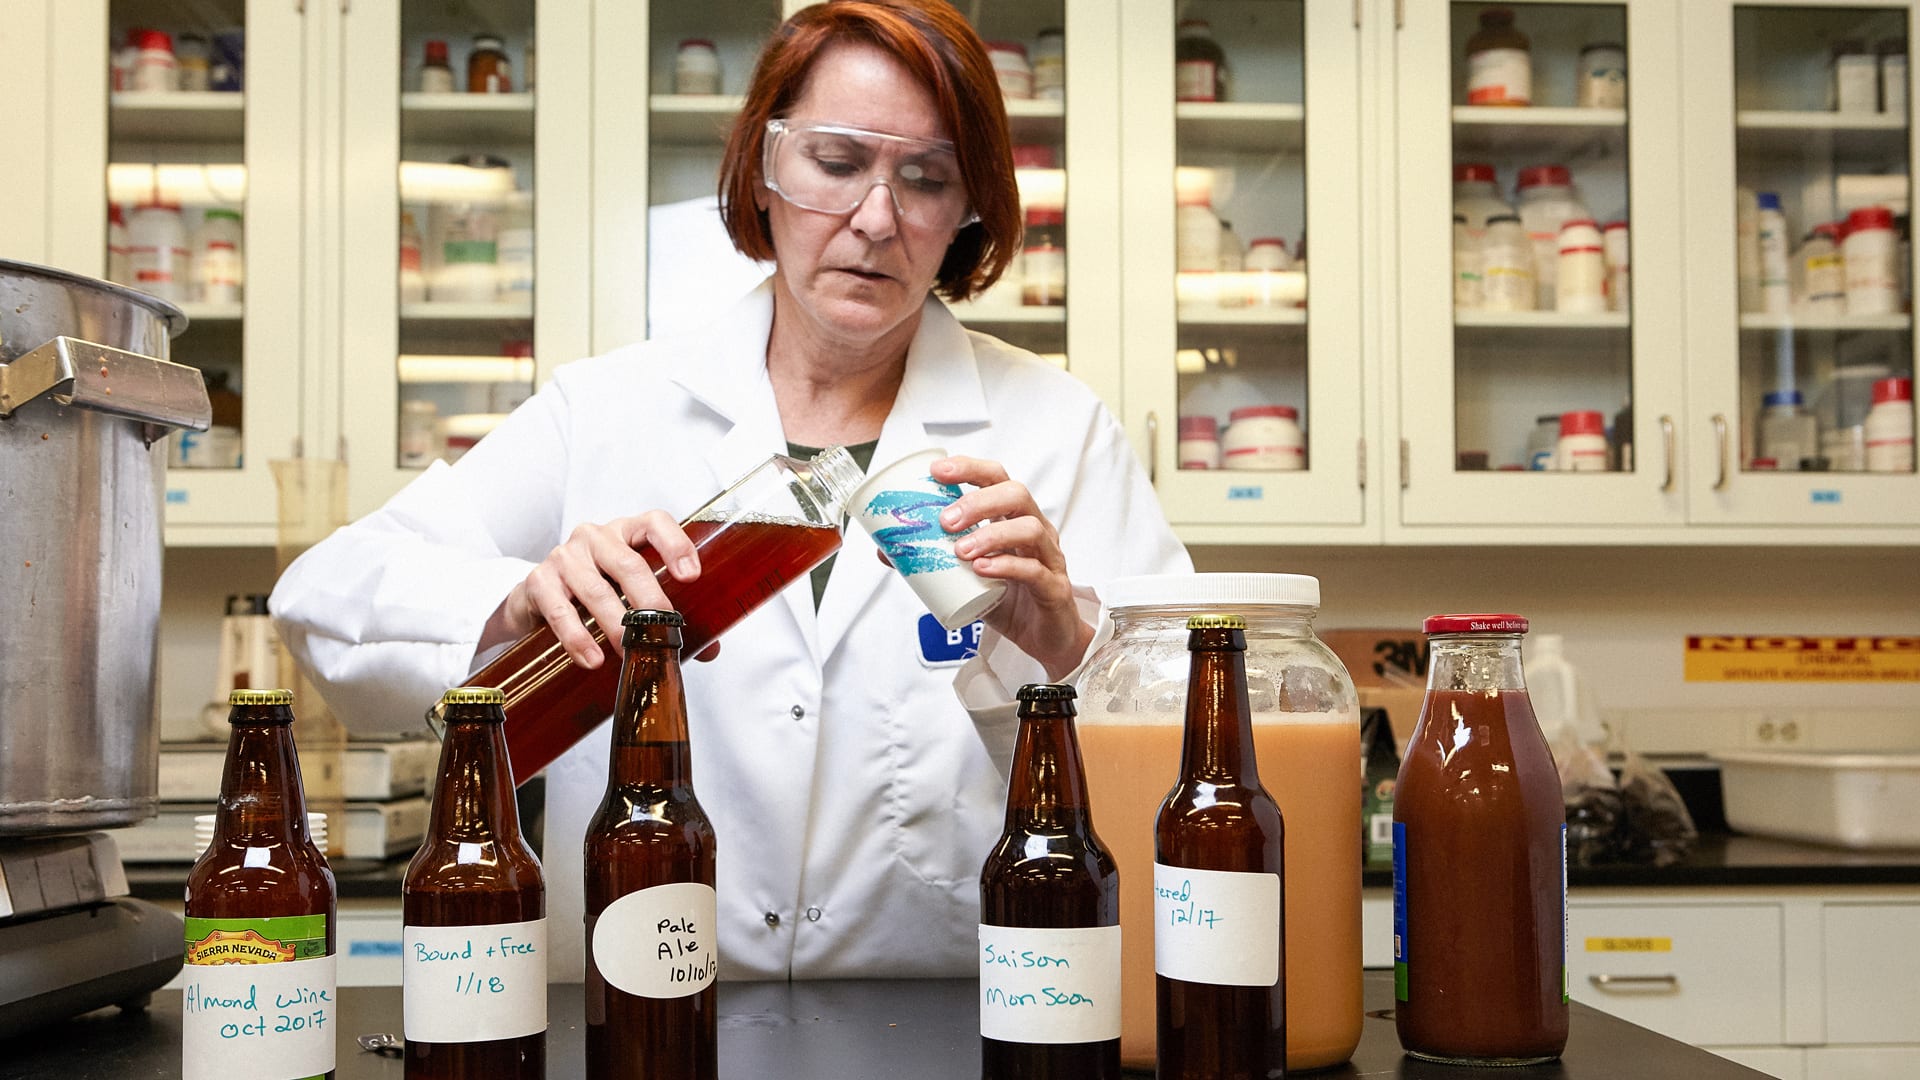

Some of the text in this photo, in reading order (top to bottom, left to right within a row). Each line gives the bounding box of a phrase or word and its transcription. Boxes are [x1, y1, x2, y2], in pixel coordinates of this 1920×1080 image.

[1470, 621, 1490, 630] Shake
[1492, 621, 1505, 629] well
[1374, 640, 1430, 677] 3M
[657, 917, 696, 934] Pale
[1171, 901, 1224, 929] 12/17
[196, 943, 277, 961] SIERRA NEVADA
[414, 940, 472, 962] Bound
[500, 936, 536, 957] Free
[658, 938, 699, 960] Ale
[670, 952, 716, 982] 10/10/17
[456, 971, 505, 995] 1/18
[186, 983, 257, 1014] Almond
[274, 1009, 327, 1033] 2017
